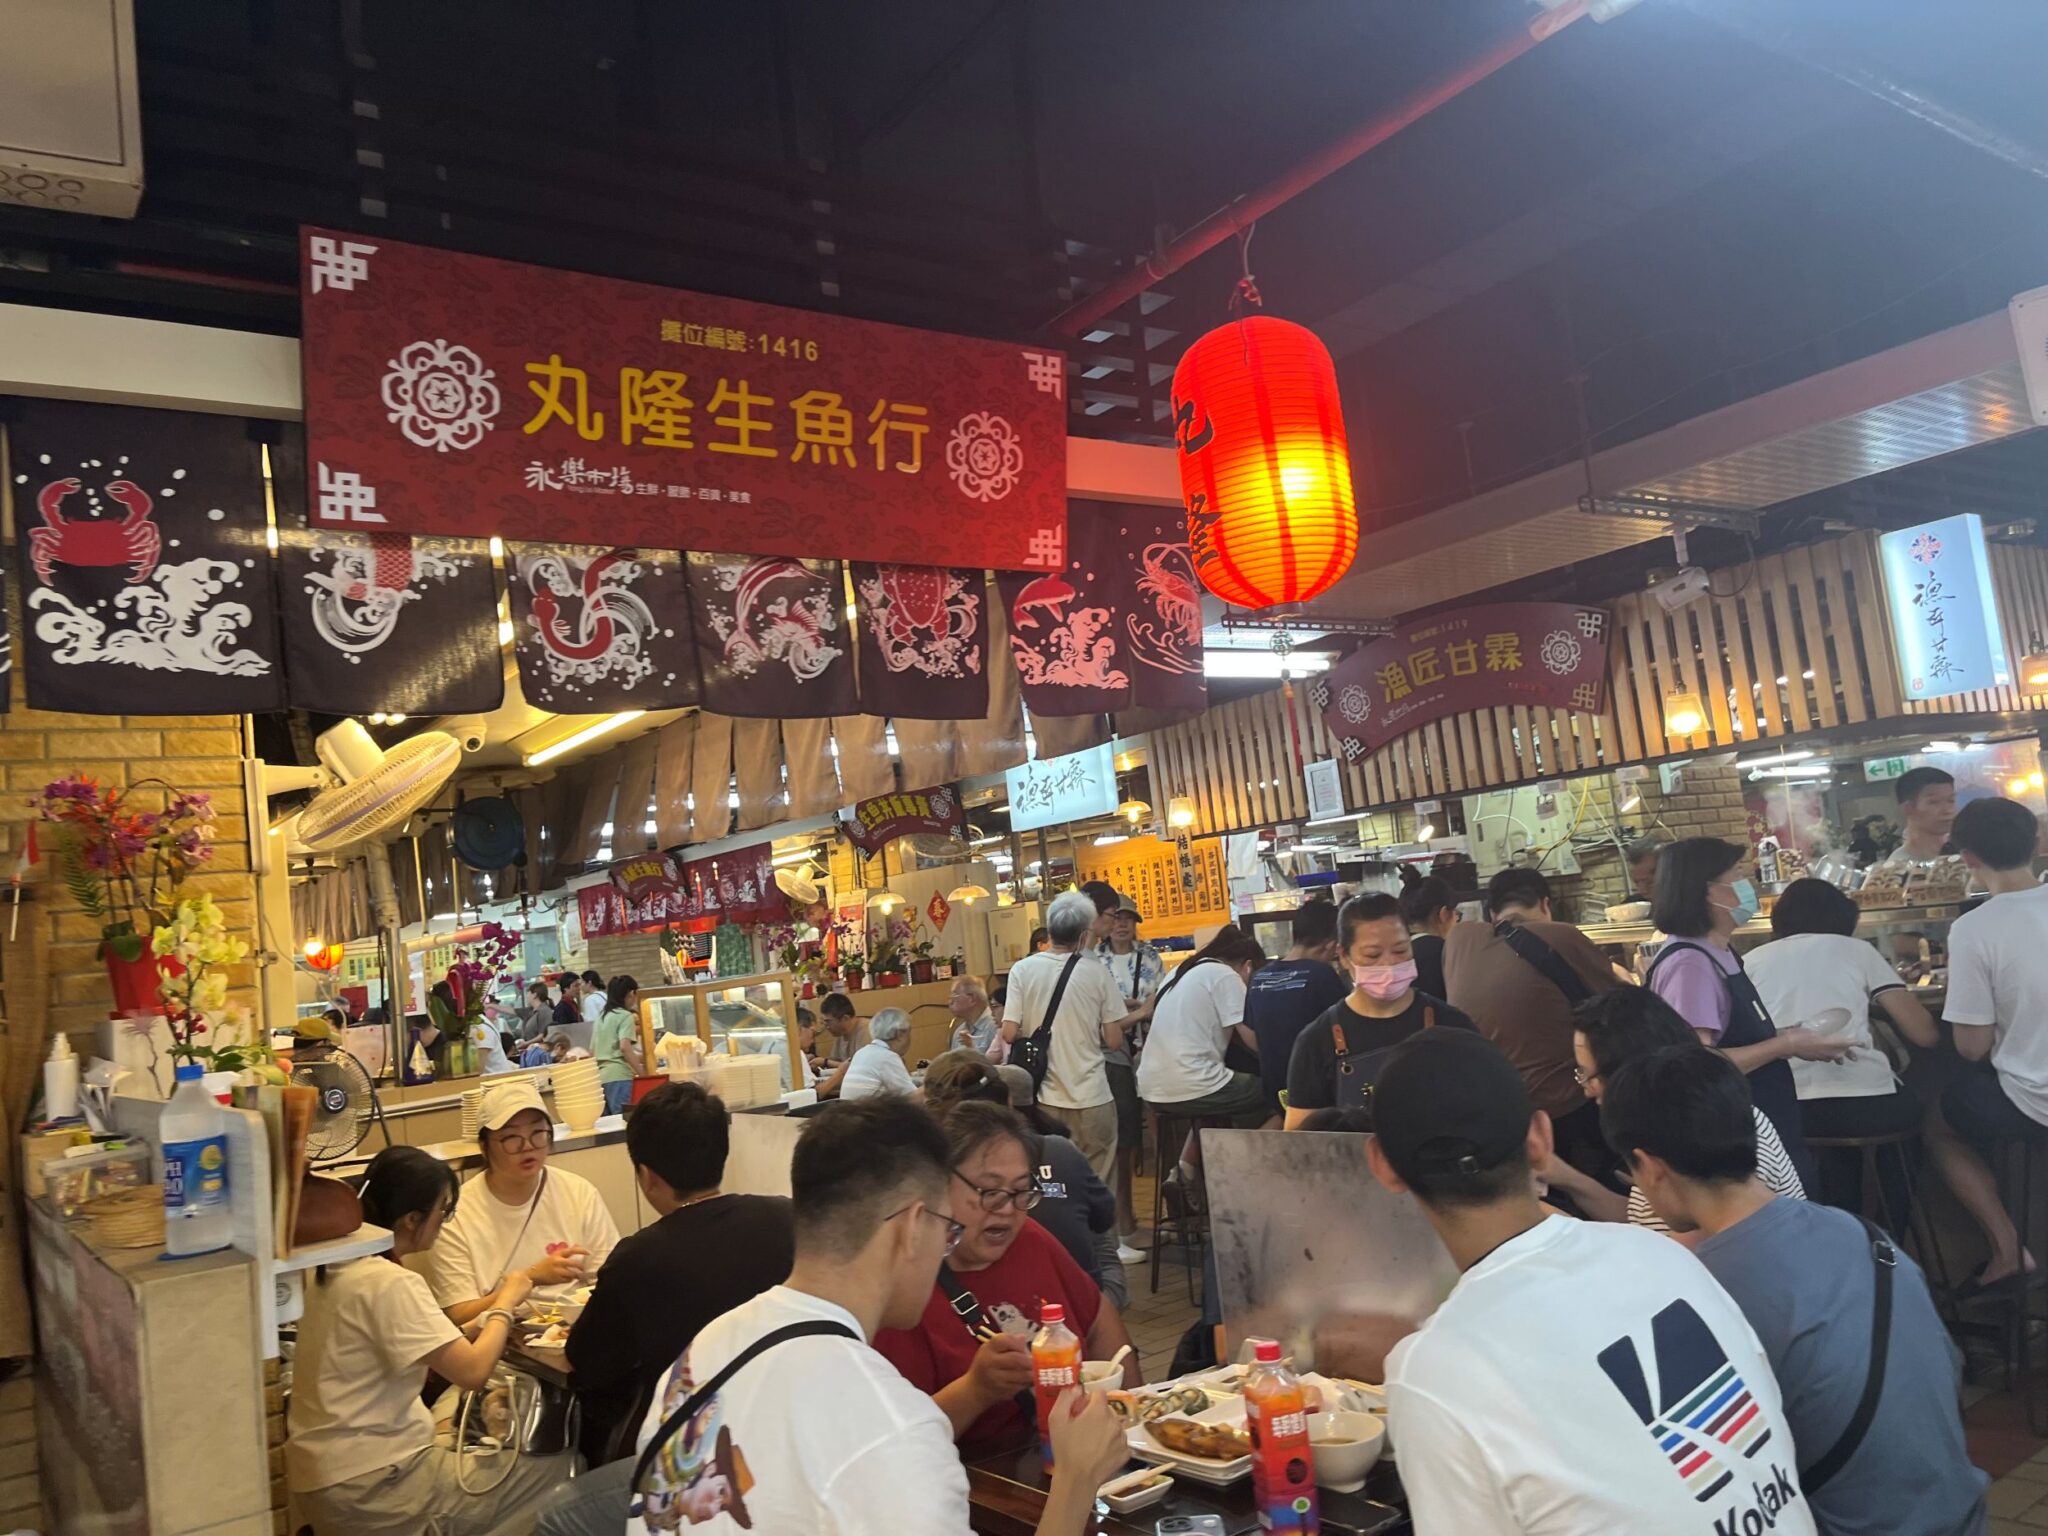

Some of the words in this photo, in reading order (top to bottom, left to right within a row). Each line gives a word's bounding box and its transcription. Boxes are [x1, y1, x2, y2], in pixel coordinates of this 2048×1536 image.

[523, 354, 930, 474] 丸隆生魚行
[1713, 1463, 1796, 1536] Kodak
